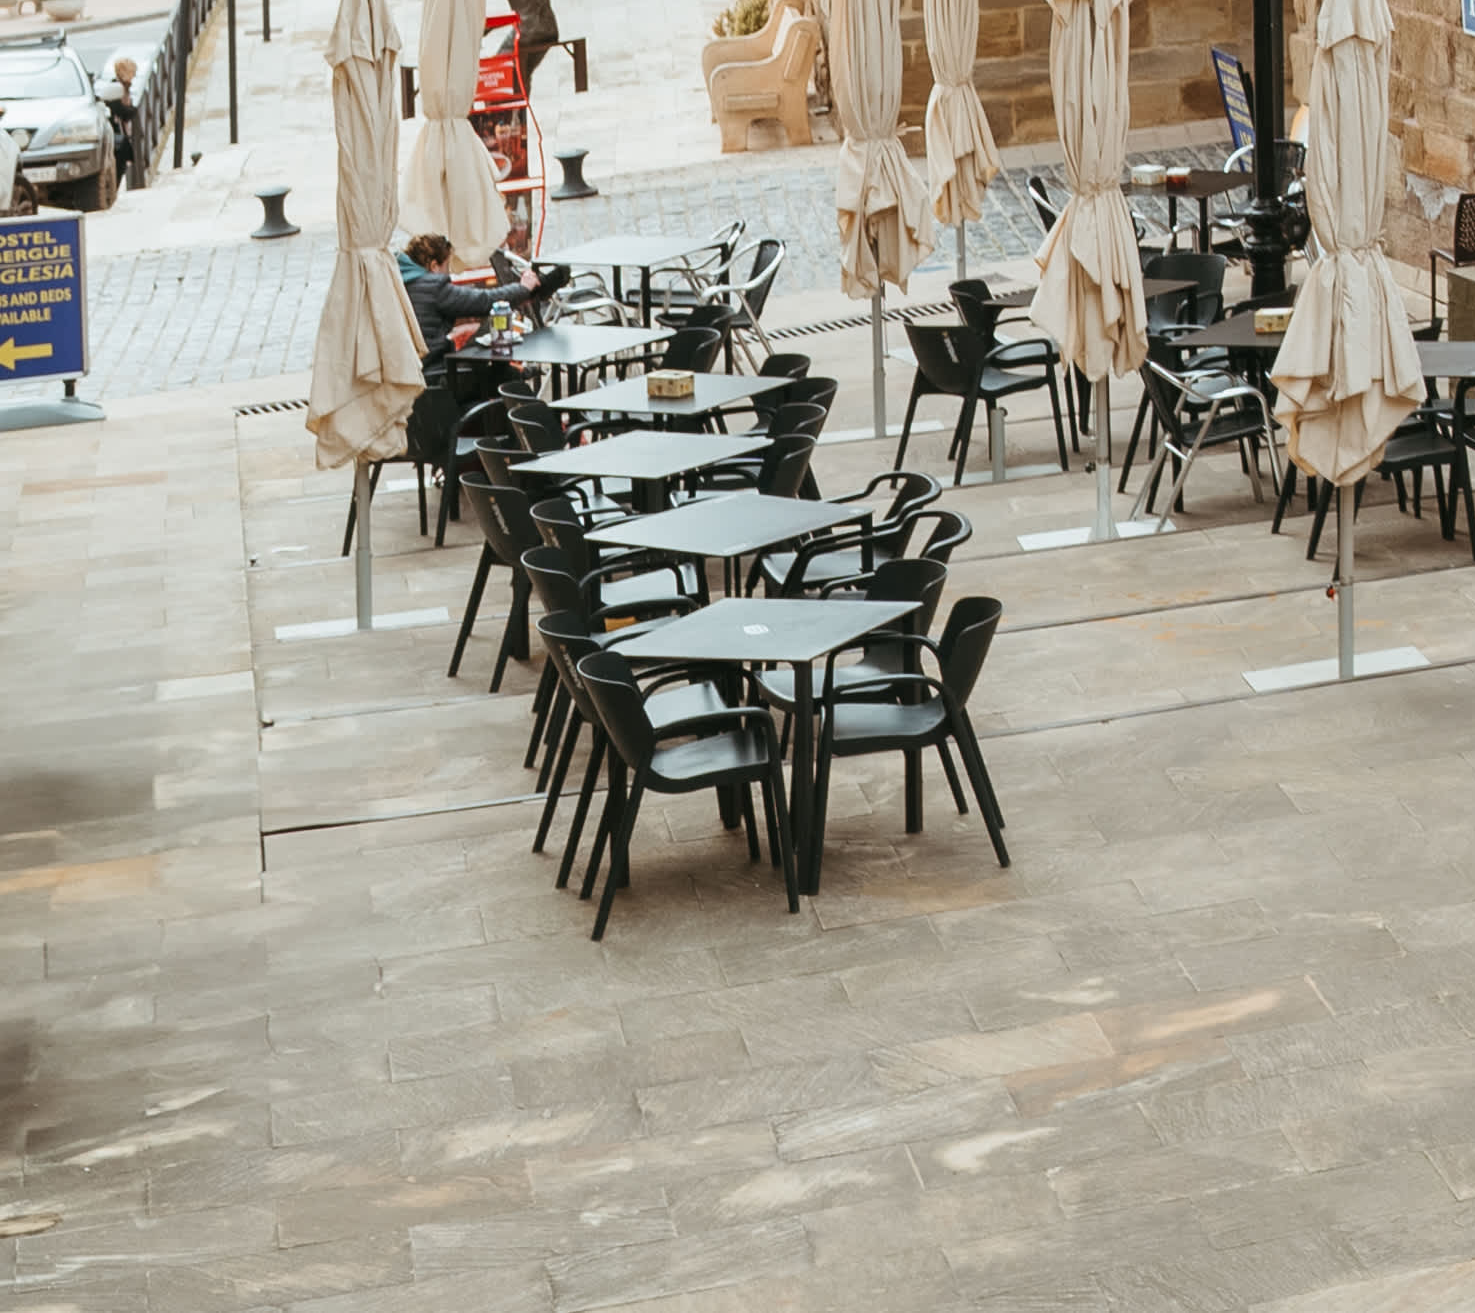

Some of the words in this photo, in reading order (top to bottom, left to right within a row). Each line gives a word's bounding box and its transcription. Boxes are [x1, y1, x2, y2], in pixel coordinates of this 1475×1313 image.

[0, 244, 71, 264] ERGUE
[10, 291, 38, 307] AND
[40, 287, 72, 303] BEDS
[0, 307, 51, 325] AILABLE
